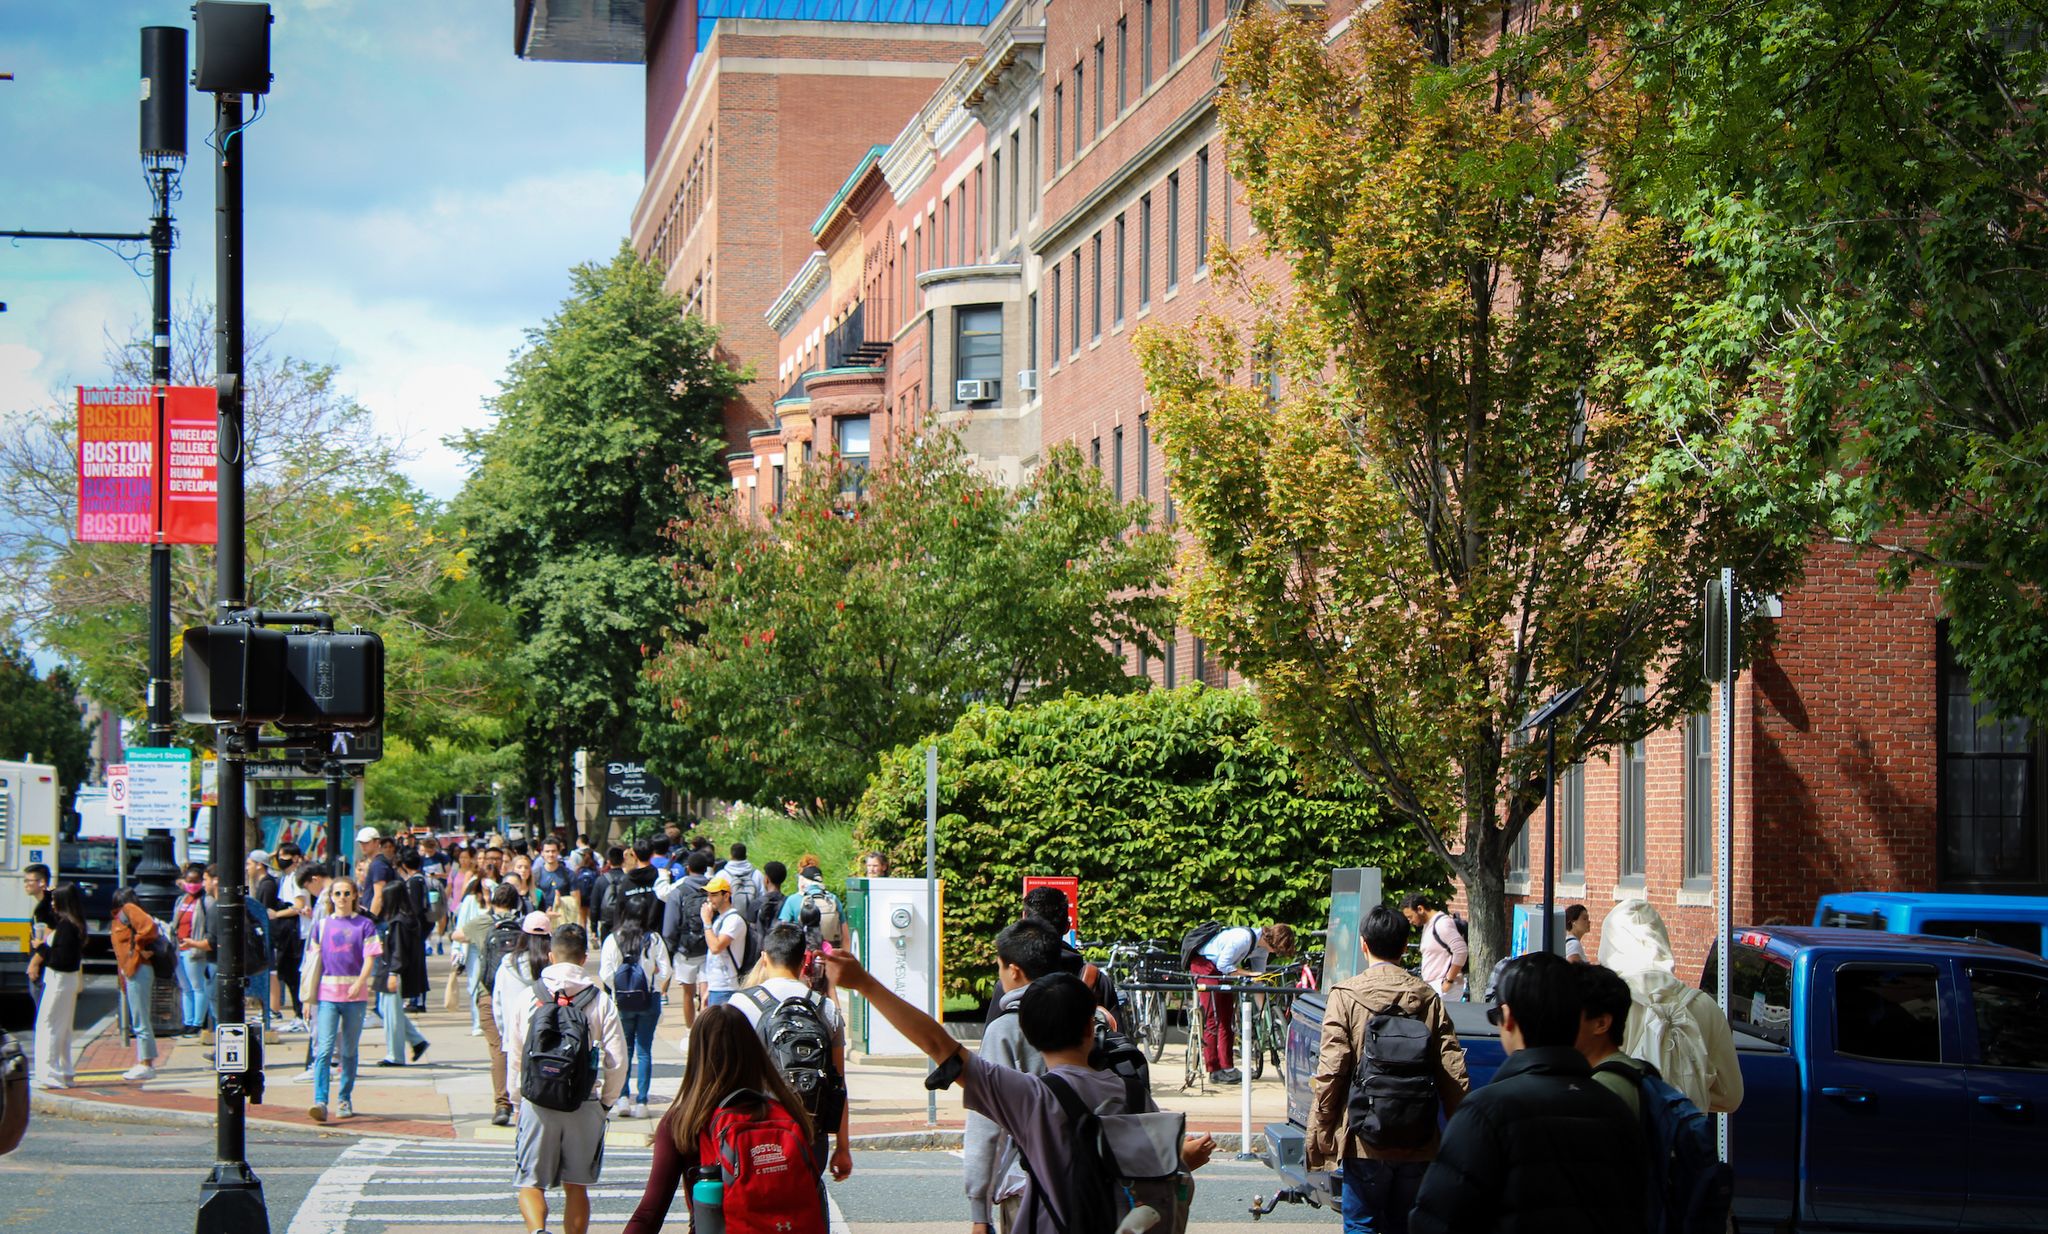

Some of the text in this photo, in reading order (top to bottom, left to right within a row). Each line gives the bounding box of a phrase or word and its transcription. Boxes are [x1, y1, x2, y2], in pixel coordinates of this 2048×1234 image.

[83, 391, 151, 405] UNIVERSITY
[83, 406, 151, 427] BOSTON
[83, 427, 151, 441] UNIVERSITY
[83, 441, 152, 462] BOSTON
[170, 442, 217, 454] COLLEGE O
[83, 463, 152, 477] UNIVERSITY
[170, 467, 204, 479] HUMAN
[83, 478, 151, 498] BOSTON
[170, 480, 217, 492] DEVELOPM
[83, 500, 151, 512] UNIVERSITY
[82, 513, 151, 534] BOSTON
[751, 1144, 782, 1156] BOSTON
